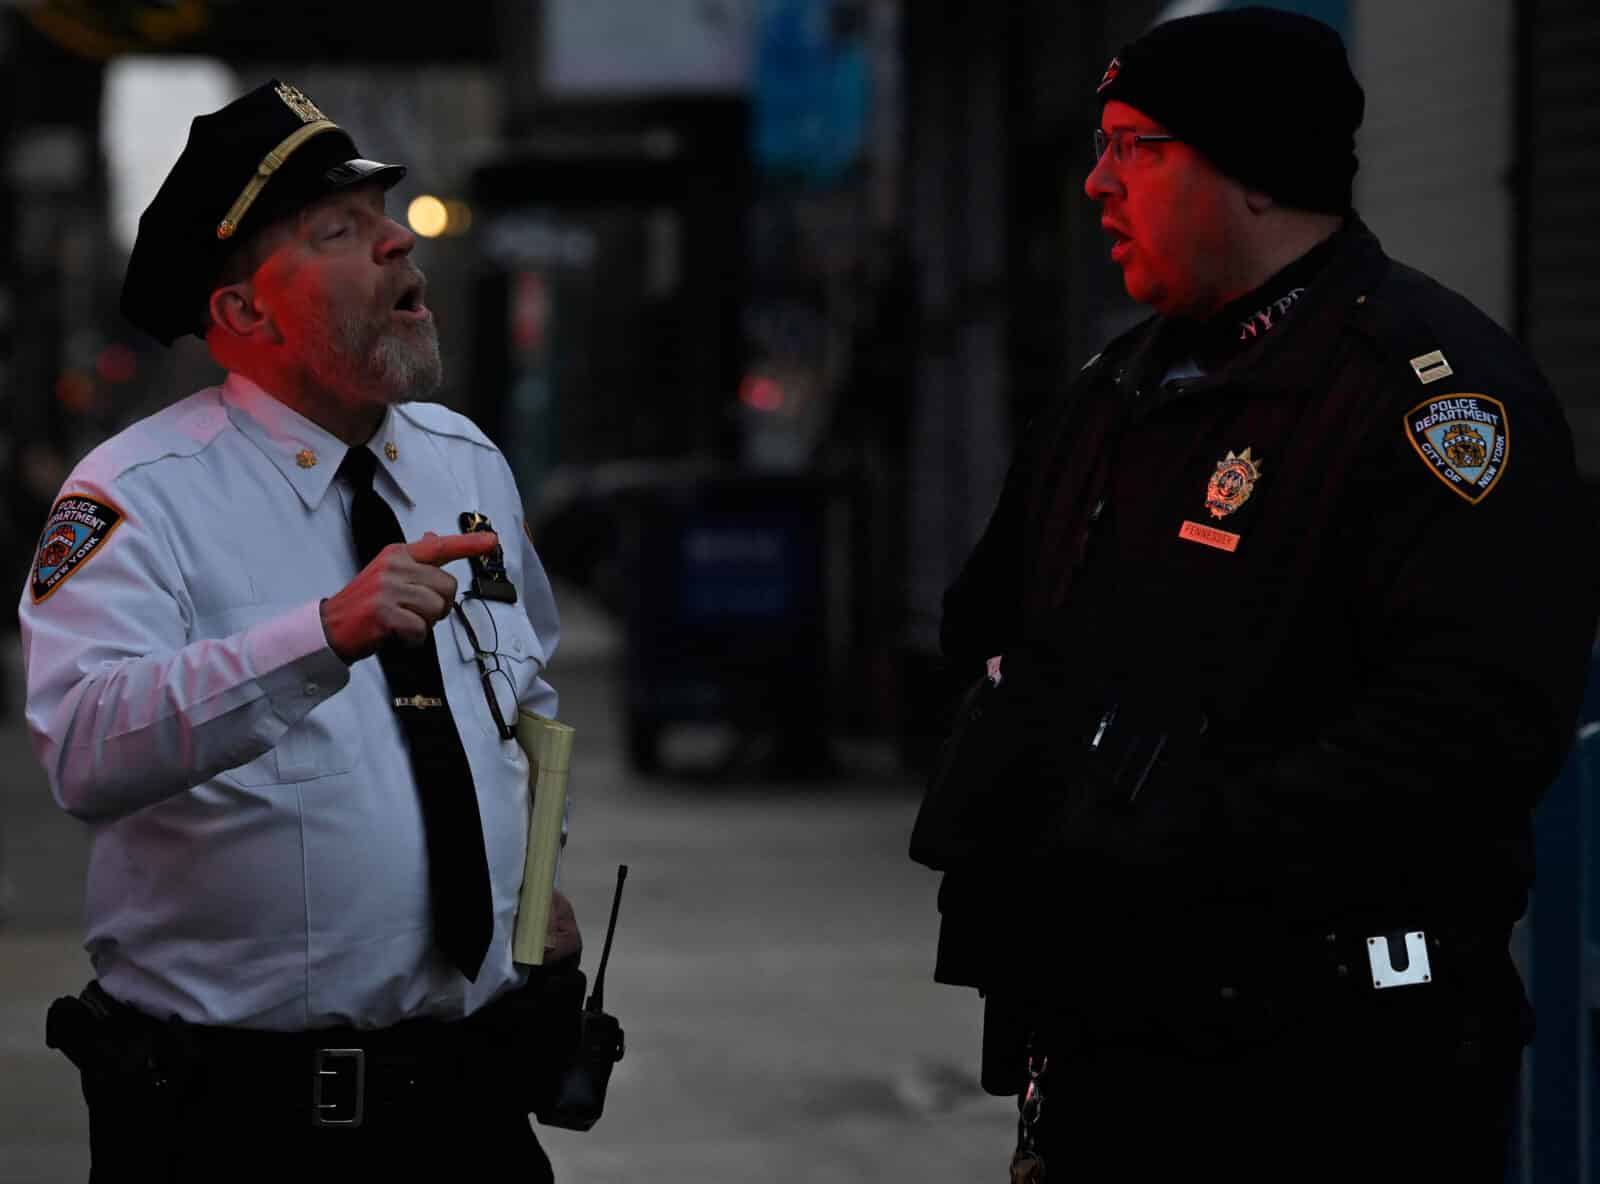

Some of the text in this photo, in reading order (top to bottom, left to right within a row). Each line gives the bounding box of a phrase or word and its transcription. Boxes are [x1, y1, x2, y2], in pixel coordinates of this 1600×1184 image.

[1429, 399, 1479, 414] POLICE
[1415, 409, 1499, 432] DEPARTMENT
[1421, 442, 1462, 483] CITY OF
[1477, 436, 1504, 488] NEW YORK
[58, 500, 98, 514] POLICE
[51, 510, 107, 530] PARTMENT
[47, 564, 69, 588] NEW
[69, 537, 99, 563] YORK
